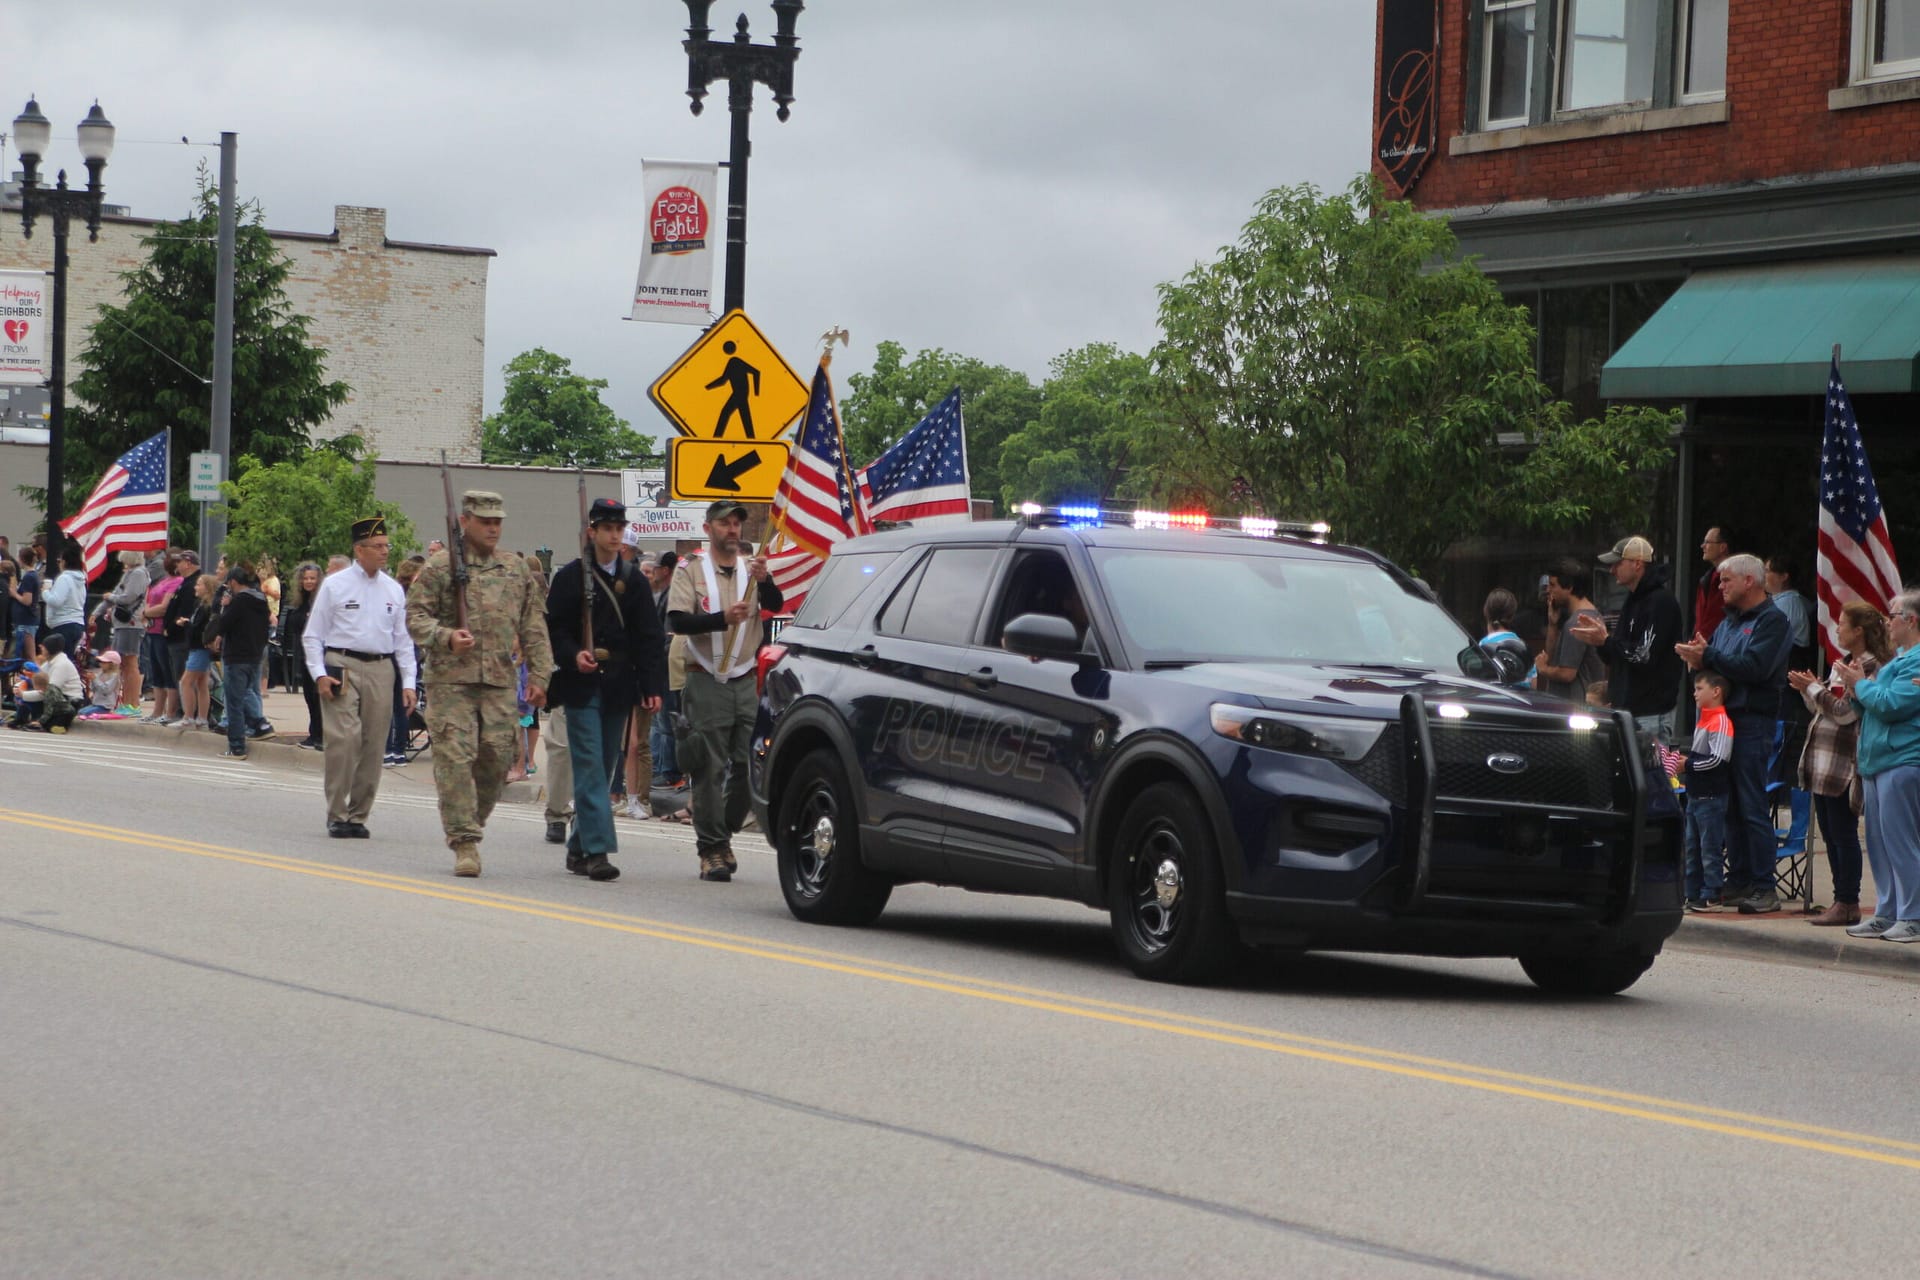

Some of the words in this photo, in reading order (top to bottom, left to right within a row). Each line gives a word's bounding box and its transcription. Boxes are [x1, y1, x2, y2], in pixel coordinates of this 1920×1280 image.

[658, 195, 699, 217] Food
[654, 215, 700, 242] Fight!
[638, 285, 658, 294] JOIN
[660, 287, 679, 296] THE
[680, 288, 708, 298] FIGHT
[19, 298, 33, 306] OUR
[0, 306, 42, 317] EIGHBORS
[3, 345, 28, 353] FROM
[644, 509, 681, 524] LOWELL
[631, 521, 691, 534] SHOWBOAT
[873, 696, 1060, 782] POLICE
